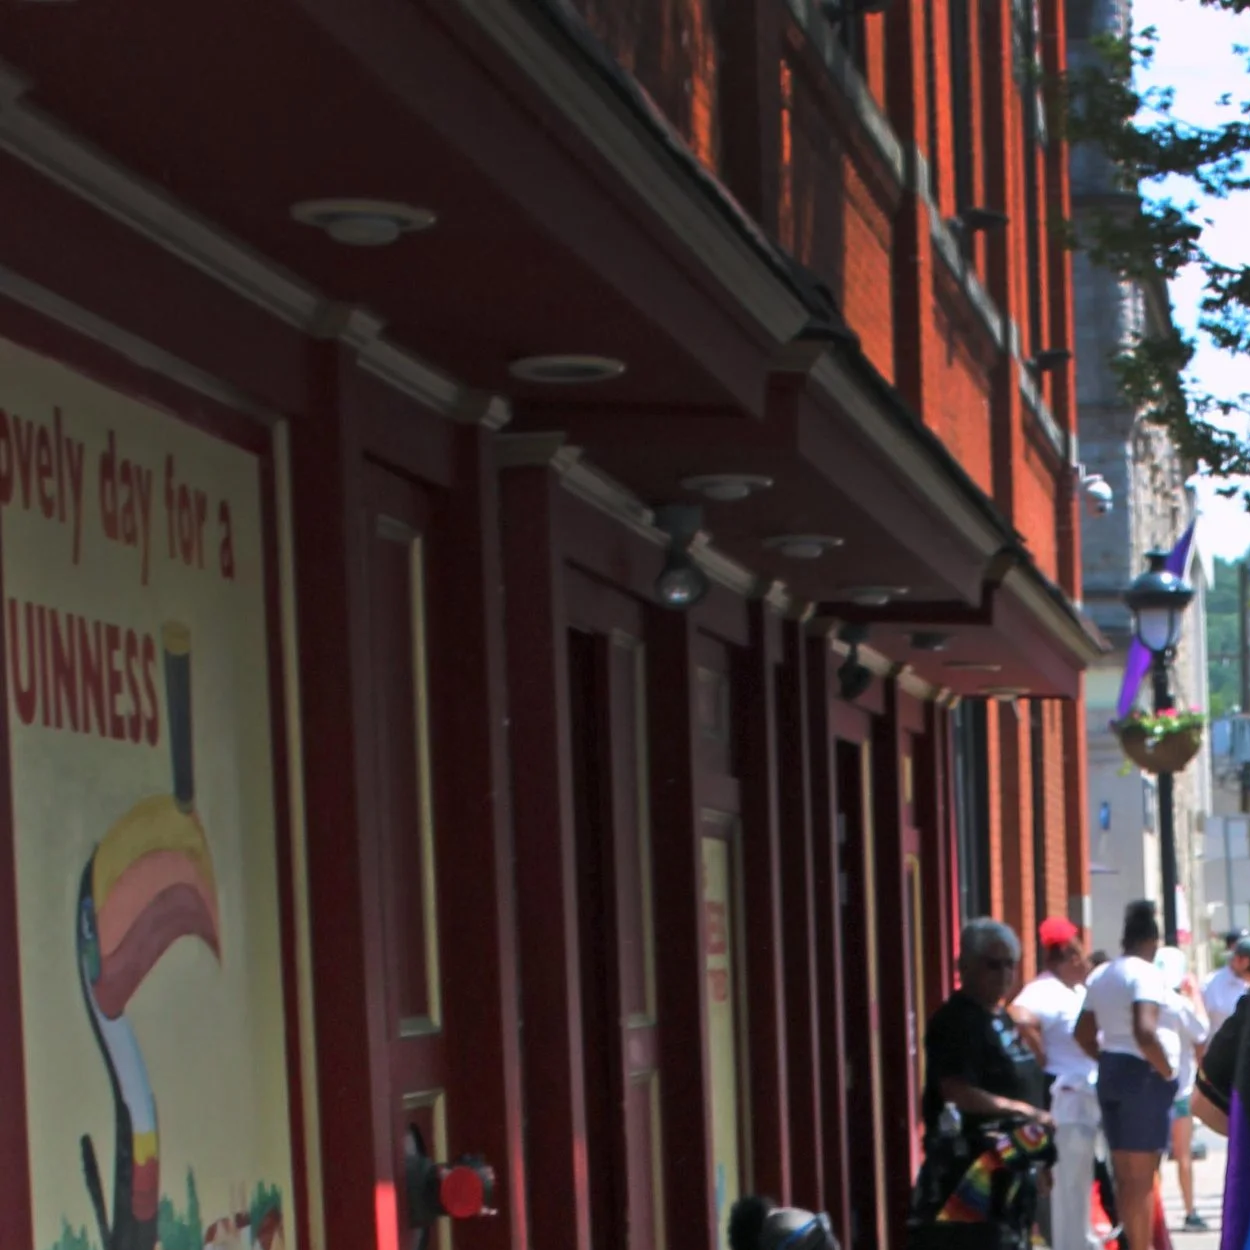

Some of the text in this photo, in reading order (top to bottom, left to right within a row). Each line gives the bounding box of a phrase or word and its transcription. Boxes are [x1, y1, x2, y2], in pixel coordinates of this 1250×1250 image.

[100, 428, 152, 587] day
[164, 453, 207, 570] for
[218, 499, 235, 581] a
[8, 597, 161, 747] UINNESS
